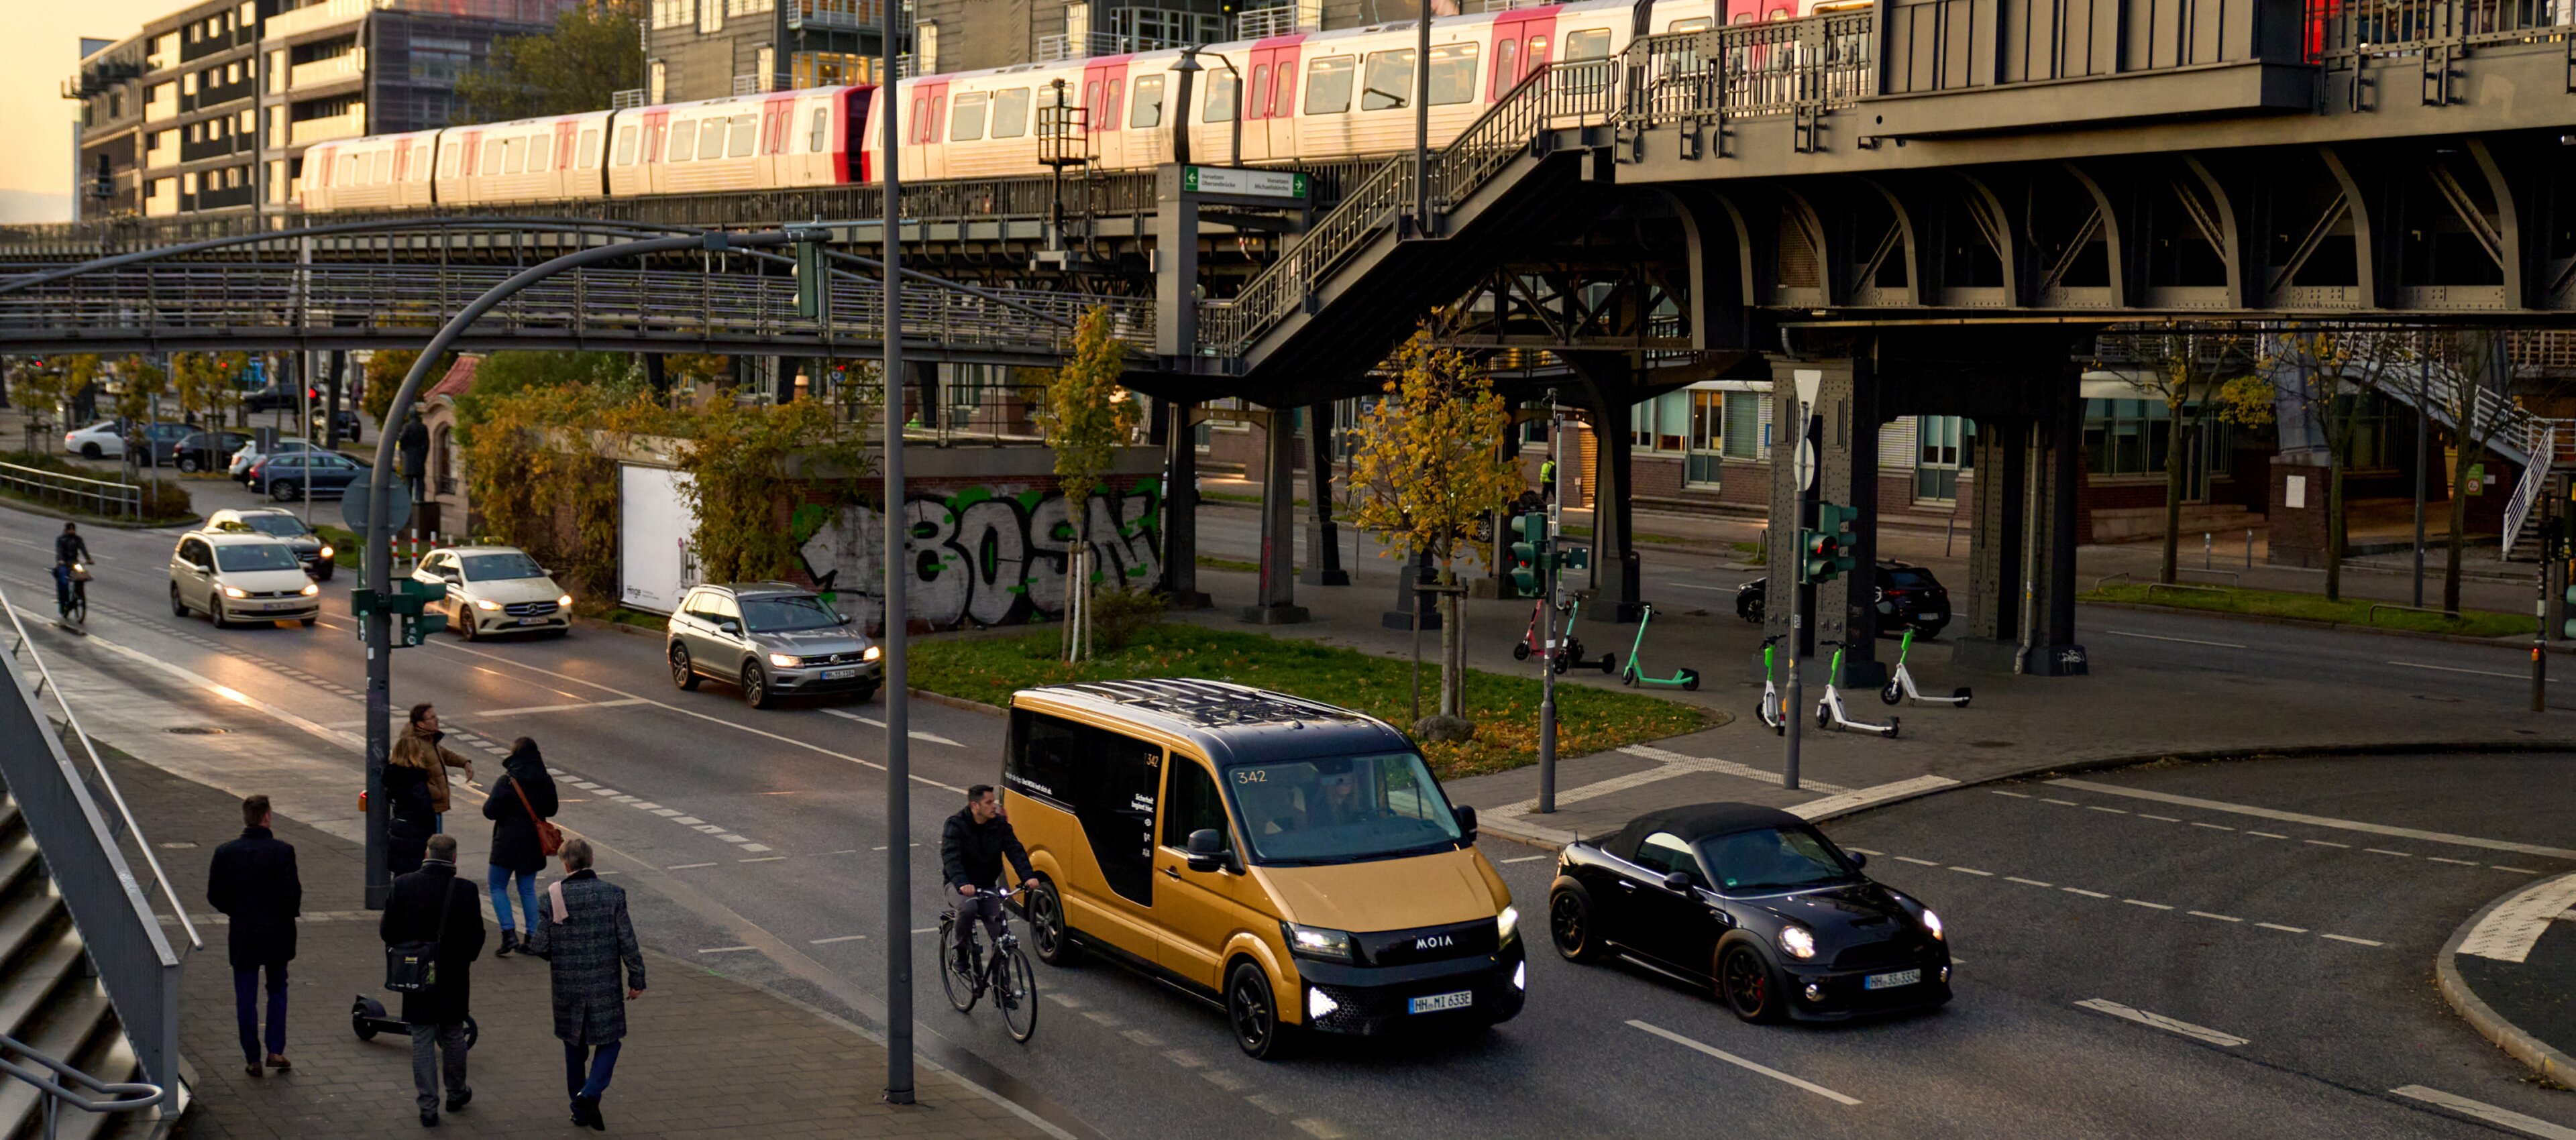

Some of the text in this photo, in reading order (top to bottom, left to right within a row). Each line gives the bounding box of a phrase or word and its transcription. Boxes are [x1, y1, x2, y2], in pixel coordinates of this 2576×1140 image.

[1146, 753, 1159, 767] 342
[1237, 770, 1267, 784] 342
[1415, 935, 1453, 950] MOIA
[1415, 992, 1470, 1011] HH MI 633E
